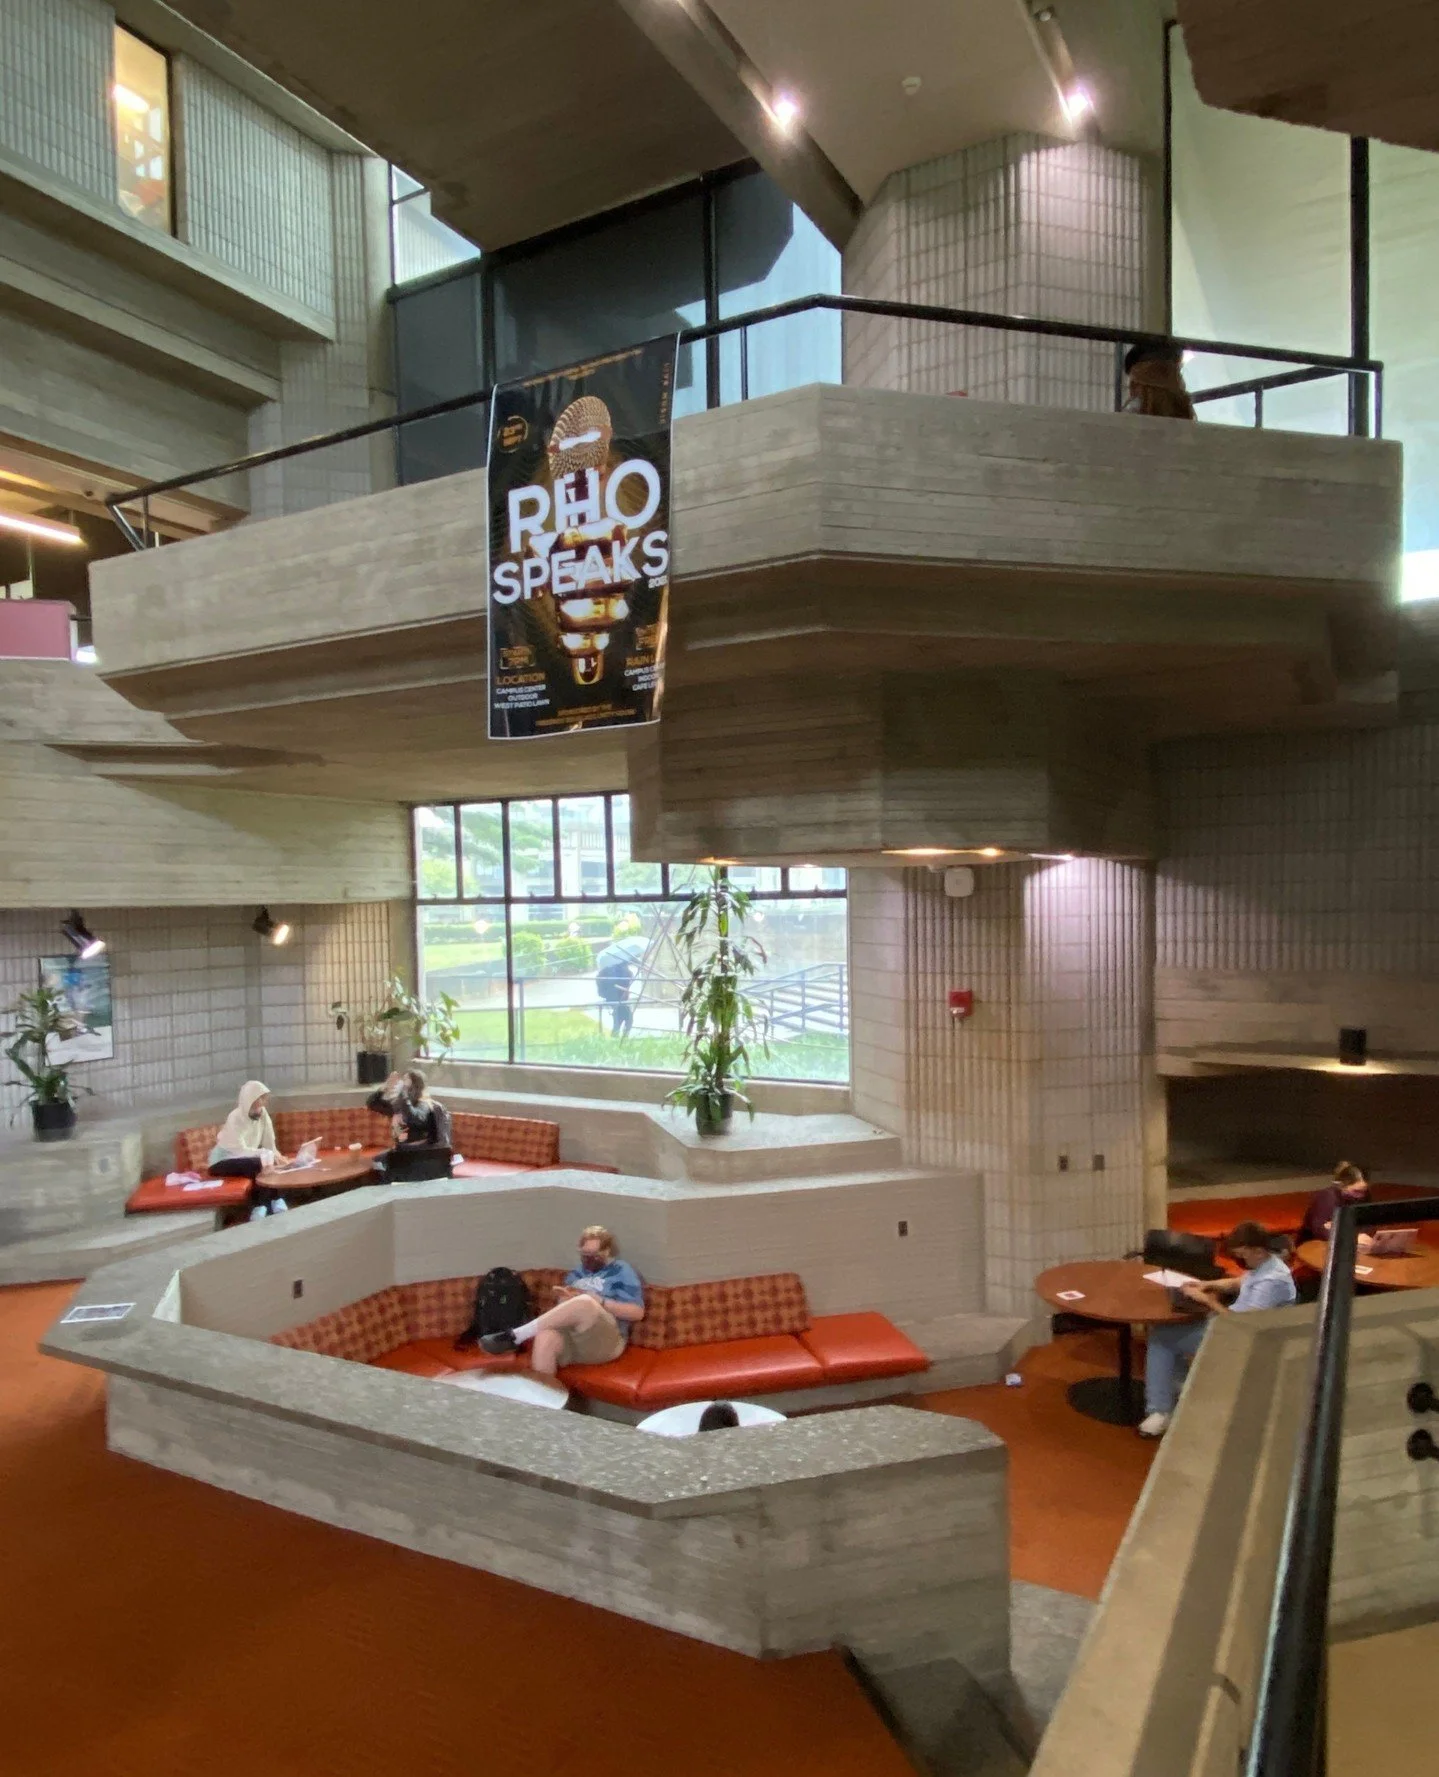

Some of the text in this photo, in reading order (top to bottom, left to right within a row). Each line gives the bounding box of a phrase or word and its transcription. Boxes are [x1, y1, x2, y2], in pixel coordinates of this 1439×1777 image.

[508, 459, 661, 554] RHO
[493, 530, 669, 604] SPEAKS
[624, 667, 650, 677] CAMPUS
[496, 672, 545, 685] LOCATION
[496, 684, 546, 695] CAMPUS CENTER
[507, 693, 538, 701] OUTDOOR
[494, 702, 514, 710] WEST
